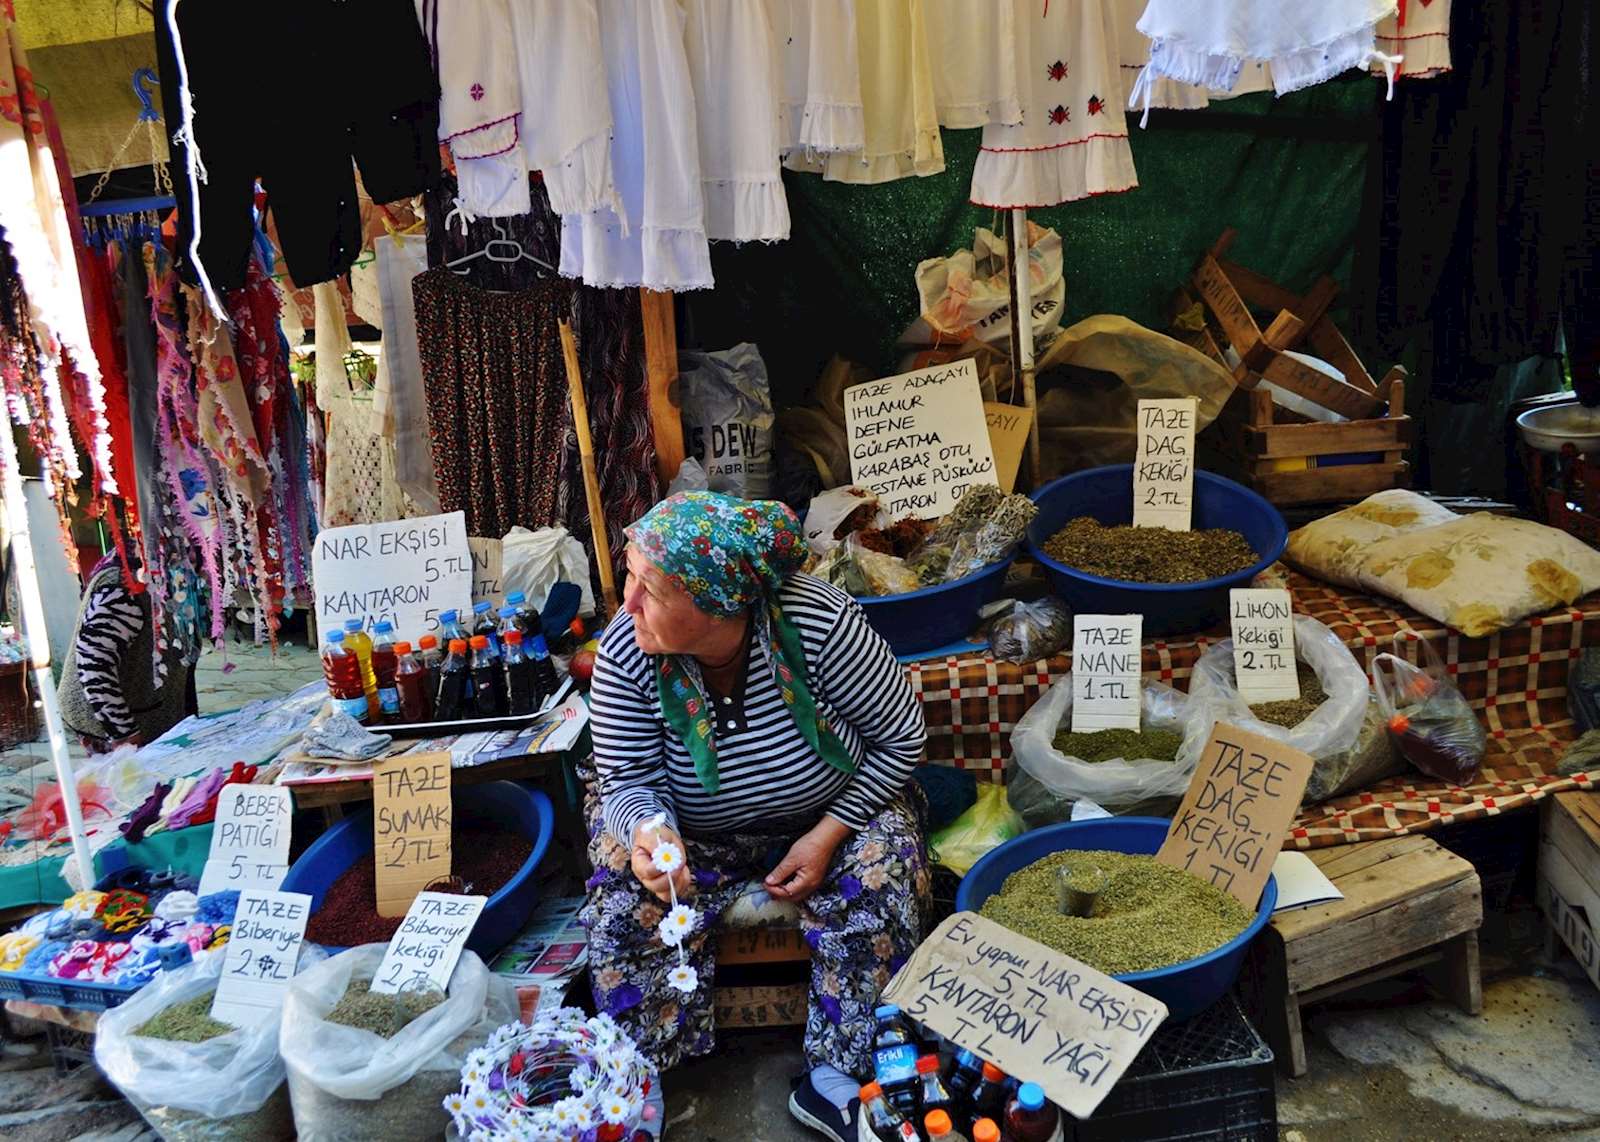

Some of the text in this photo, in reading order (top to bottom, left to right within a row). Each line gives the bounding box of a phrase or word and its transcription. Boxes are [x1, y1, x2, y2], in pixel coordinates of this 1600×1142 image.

[848, 366, 969, 402] TAZE ADAÇAYI
[852, 395, 925, 420] IHLAMUR
[1141, 407, 1190, 429] TAZE
[855, 416, 916, 439] DEFNE
[854, 432, 941, 459] GÜLFATMA
[857, 444, 972, 480] KARABAŞ OTU
[870, 473, 927, 496] ESTANE
[322, 522, 448, 561] NAR EKŞİSİ
[323, 585, 430, 616] KANTARON
[1235, 598, 1289, 620] LİMON
[1080, 628, 1133, 646] TAZE
[1080, 653, 1140, 675] NANE
[381, 764, 447, 798] TAZE
[1210, 740, 1292, 798] TAZE
[233, 793, 288, 817] BEBEK
[1195, 779, 1259, 833] DAĞ
[247, 898, 304, 920] TAZE
[421, 900, 476, 916] TAZE
[235, 919, 301, 952] Biberiye
[945, 918, 975, 945] Ev
[1029, 960, 1080, 1001] NAR
[1079, 986, 1159, 1038] EKŞİSİ
[919, 964, 1041, 1045] KANTARON
[1043, 1032, 1112, 1087] YAĞI
